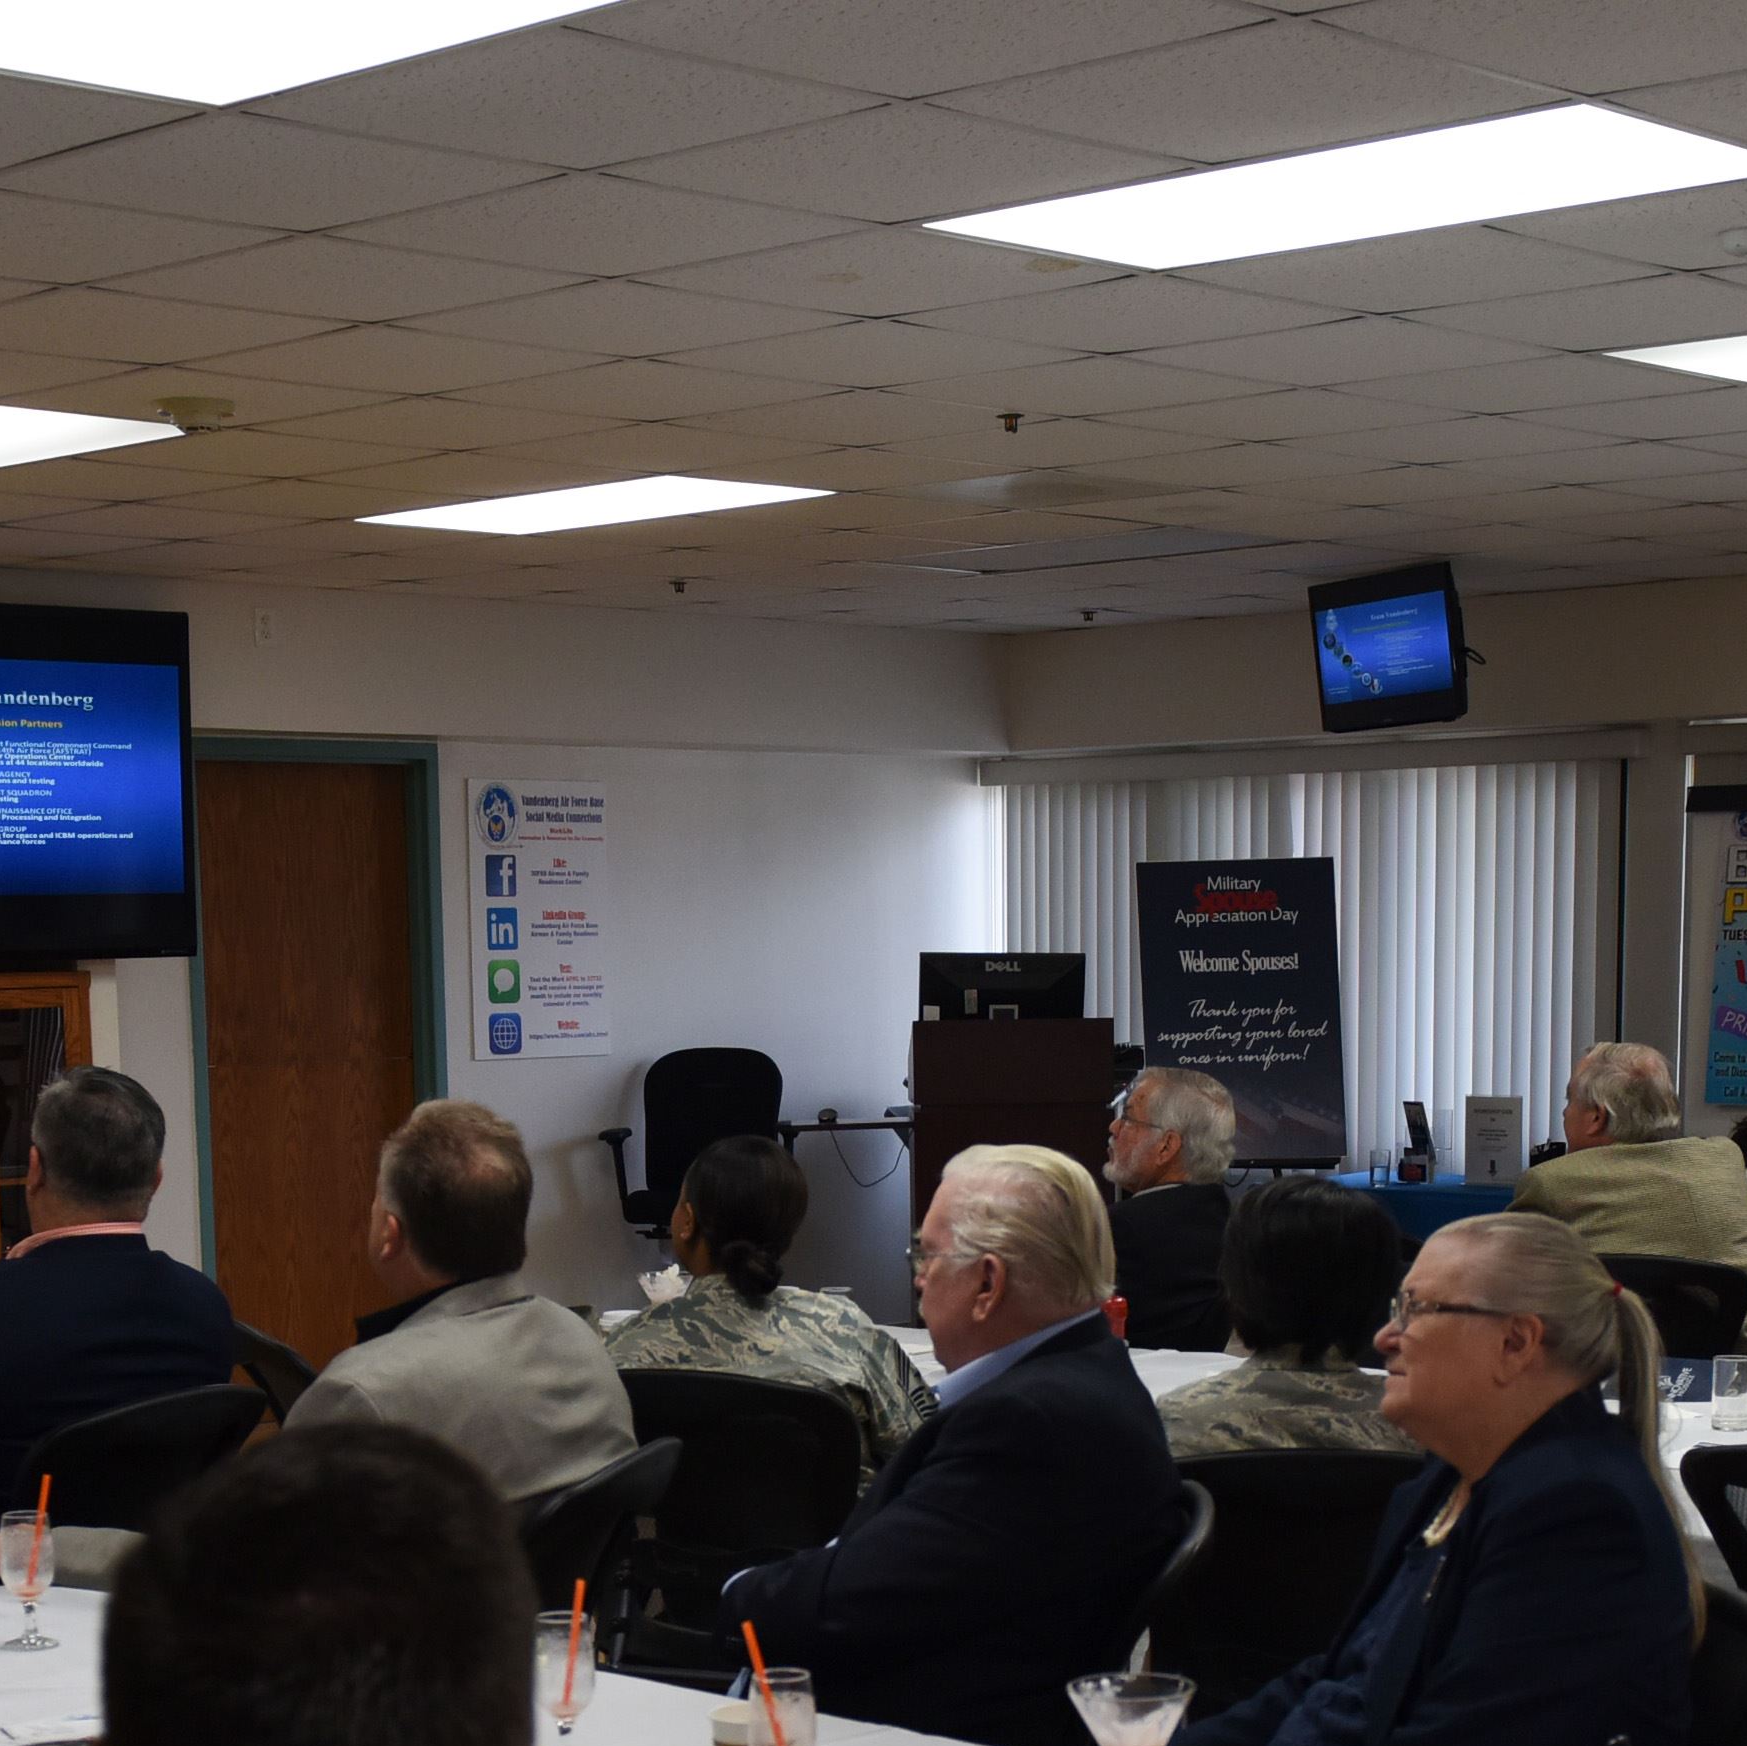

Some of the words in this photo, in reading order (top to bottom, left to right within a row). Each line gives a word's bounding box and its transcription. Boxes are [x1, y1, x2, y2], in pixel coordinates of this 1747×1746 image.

[21, 718, 63, 729] Partners
[521, 795, 558, 807] Vandenberg
[561, 795, 570, 807] Air
[525, 811, 544, 822] Social
[546, 811, 564, 823] Media
[566, 812, 602, 823] Connections
[1207, 876, 1261, 892] Military
[1192, 882, 1279, 918] Spouse
[1175, 908, 1267, 928] Appreciation
[1270, 907, 1299, 925] Day
[985, 961, 1022, 972] DELL
[1179, 950, 1240, 973] Welcome
[1241, 950, 1299, 975] Spouses!
[1188, 999, 1238, 1018] Thank
[1241, 1007, 1272, 1027] you
[1273, 999, 1296, 1024] for
[1157, 1025, 1242, 1048] supporting
[1245, 1029, 1285, 1050] your
[1288, 1020, 1328, 1038] loved
[1179, 1054, 1214, 1065] ones
[1214, 1050, 1234, 1064] in
[1238, 1044, 1311, 1071] uniform!
